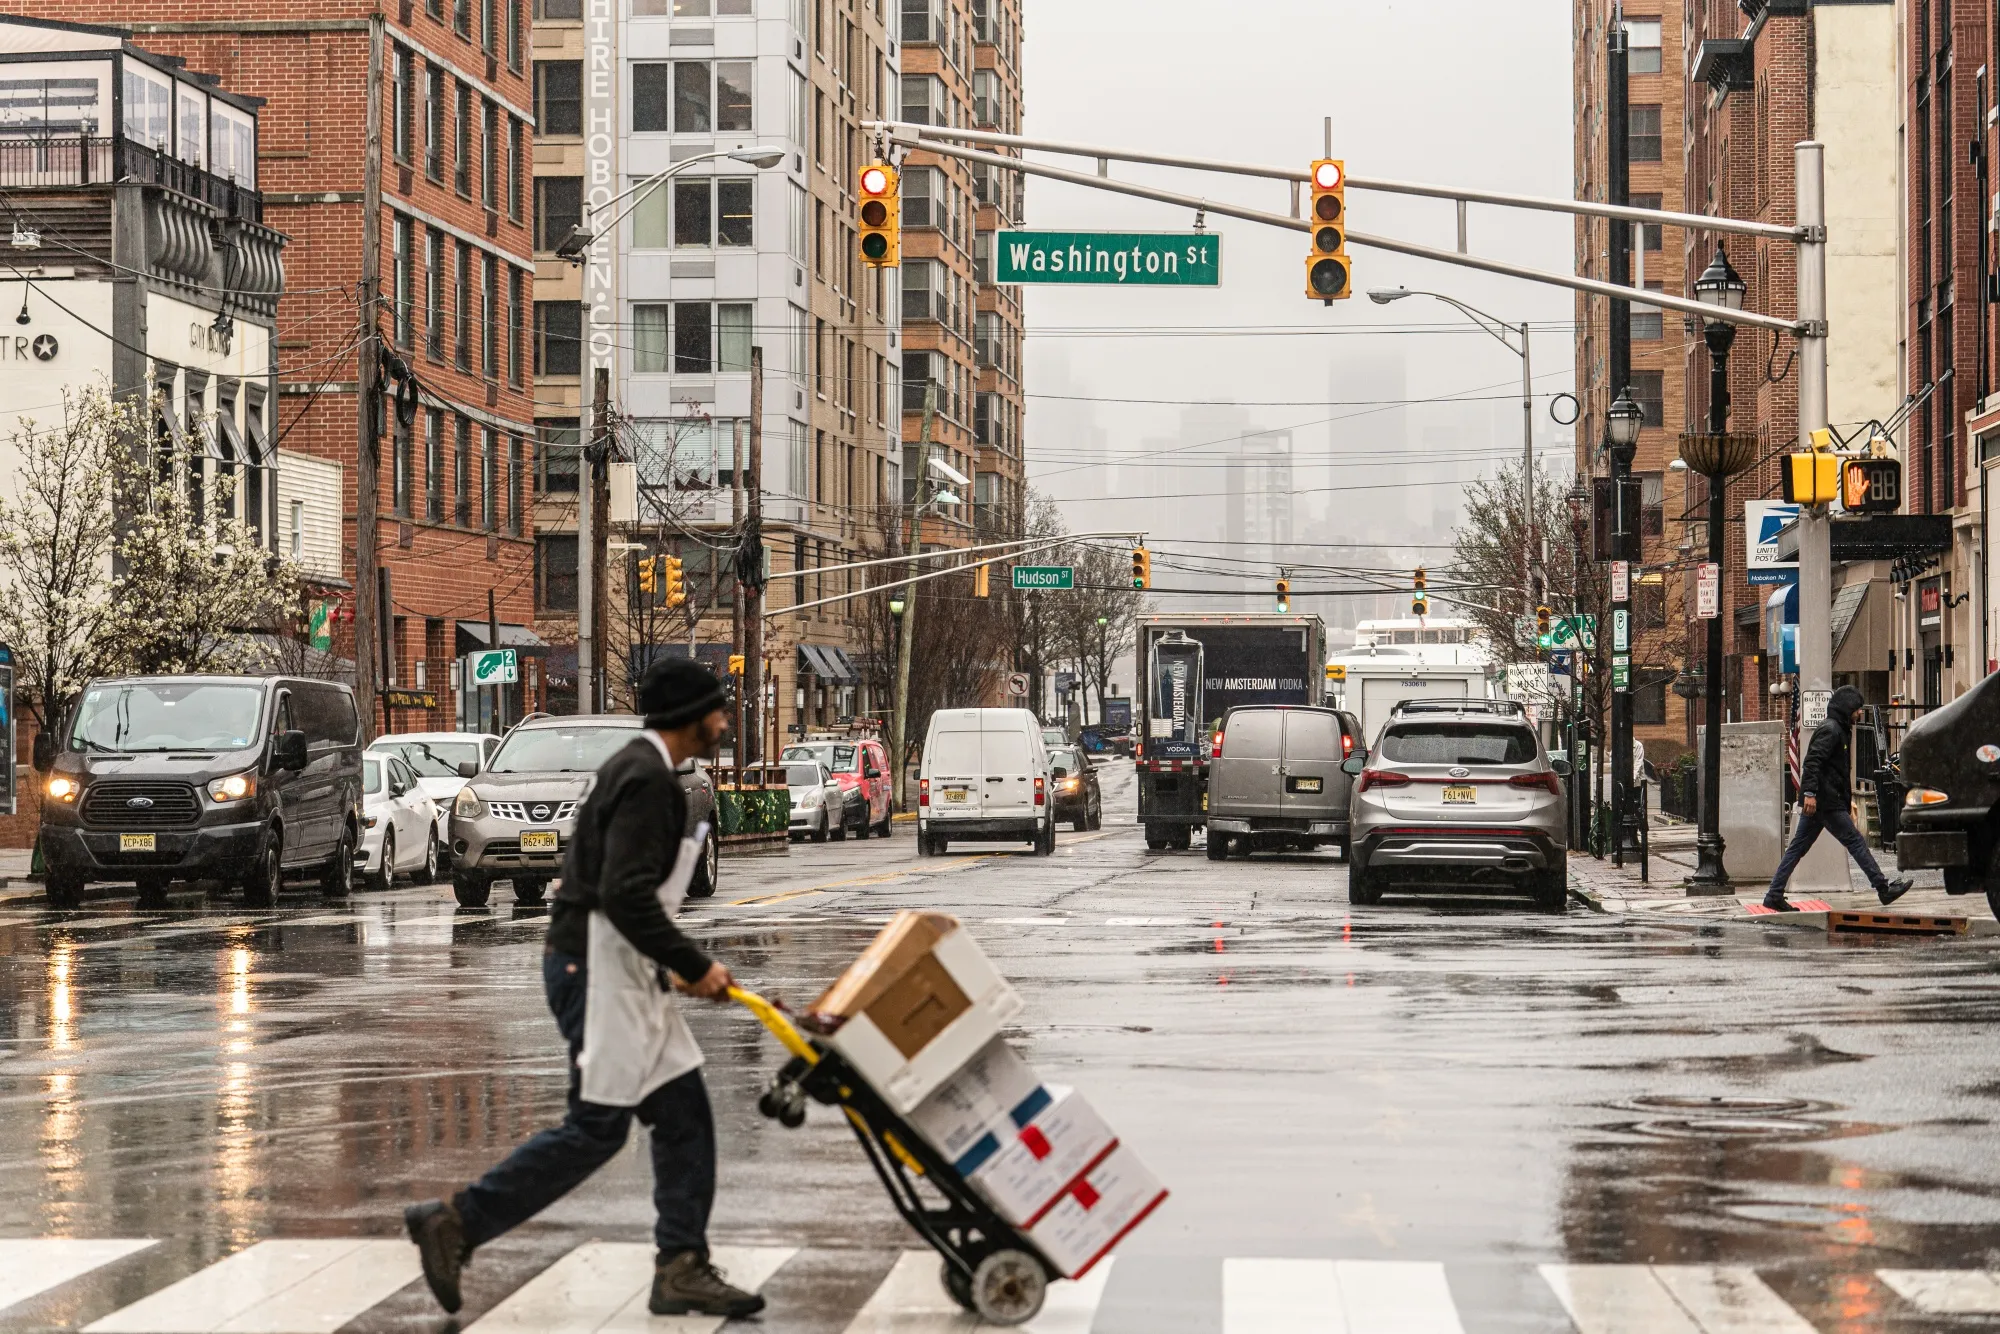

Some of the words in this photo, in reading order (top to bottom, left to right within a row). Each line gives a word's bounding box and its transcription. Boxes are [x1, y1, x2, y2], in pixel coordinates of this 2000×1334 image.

[1009, 243, 1178, 281] Washington
[1186, 246, 1208, 266] St
[1017, 570, 1059, 585] Hudson
[1061, 570, 1069, 579] ST
[505, 651, 513, 664] 2
[1173, 660, 1185, 679] NEW
[549, 677, 568, 687] SPA
[1205, 678, 1223, 690] NEW
[1224, 678, 1277, 690] AMSTERDAM
[1278, 678, 1303, 690] VODKA
[1173, 679, 1185, 730] AMSTERDAM
